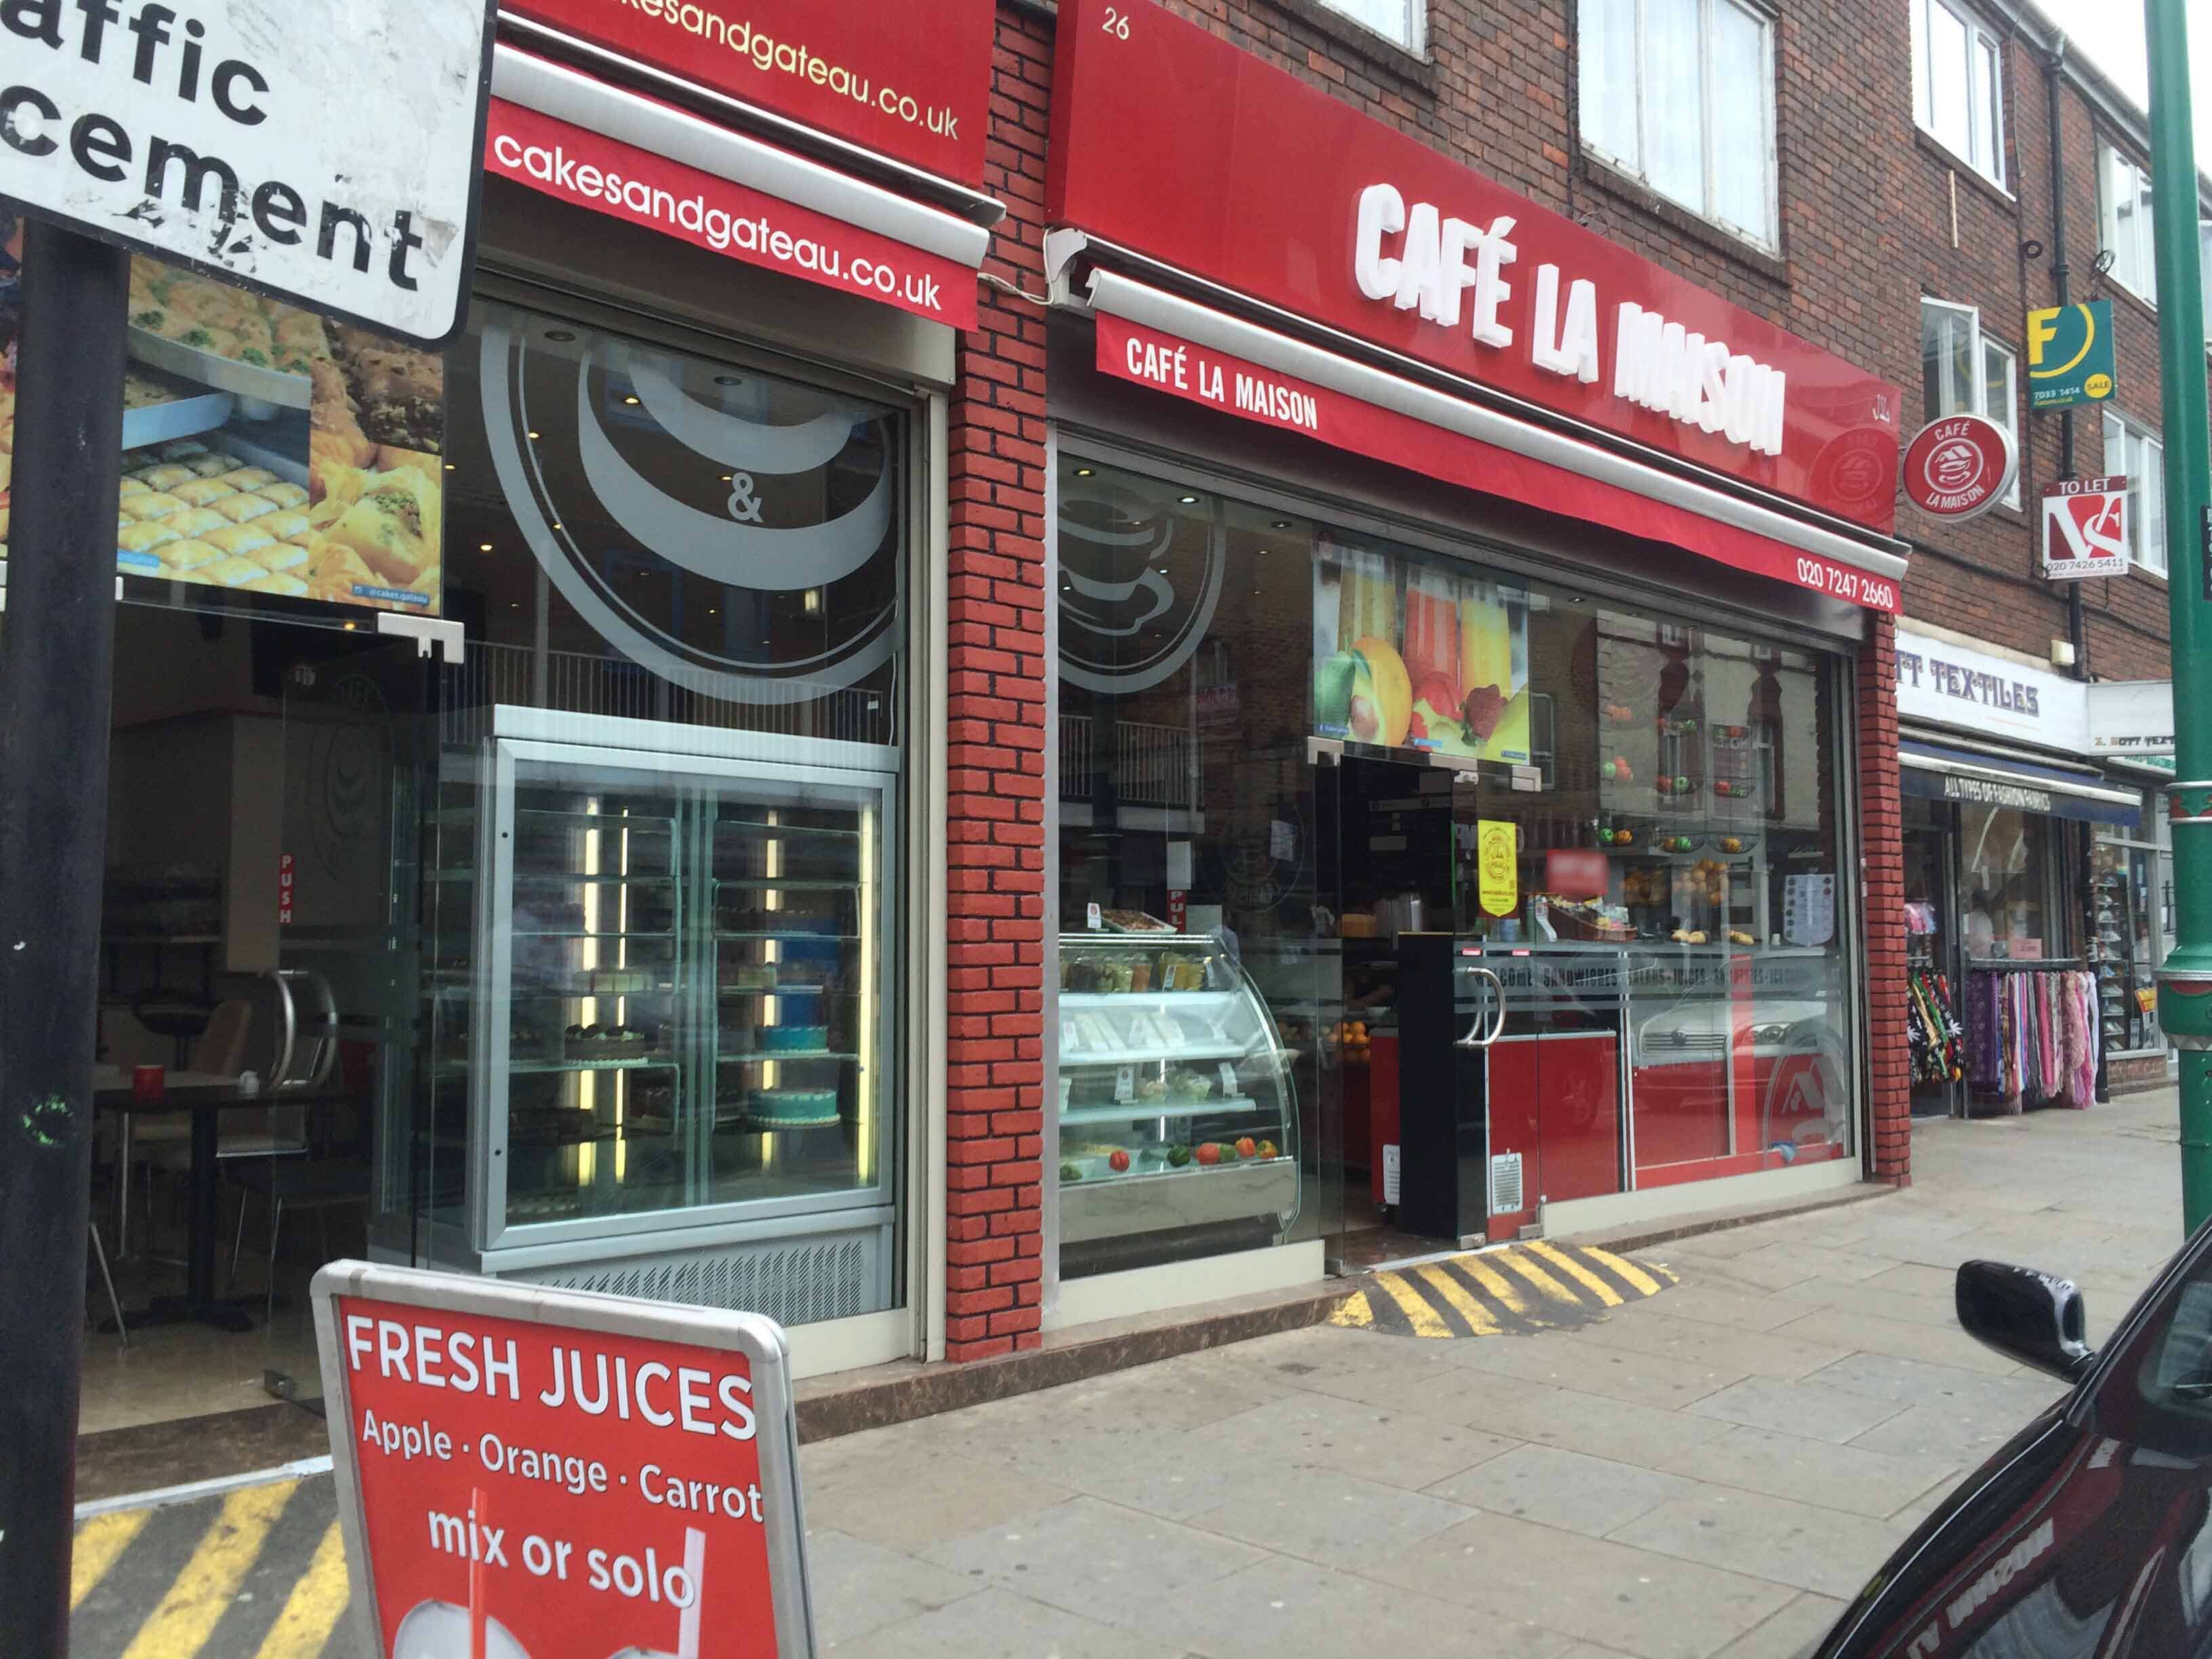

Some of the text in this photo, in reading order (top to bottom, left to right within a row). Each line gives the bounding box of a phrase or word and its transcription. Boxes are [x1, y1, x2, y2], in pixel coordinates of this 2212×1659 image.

[1102, 7, 1130, 41] 26
[0, 85, 424, 291] cement
[494, 134, 942, 311] cakesandgateau.co.uk
[1354, 182, 1786, 456] CAFÉ LA MAISON
[1126, 337, 1318, 430] CAFÉ LA MAISON
[2034, 390, 2056, 400] 7033
[2087, 380, 2110, 391] SALE
[1933, 421, 1969, 441] CAFÉ
[726, 472, 764, 523] &
[1925, 485, 1984, 509] LA MAISON
[2059, 478, 2110, 495] TO LET
[1797, 558, 1893, 608] 020 7247 2660
[2070, 560, 2095, 570] 7426
[2097, 558, 2124, 567] 5411
[1929, 658, 2040, 718] TEXTILES
[281, 855, 293, 924] PUSH
[345, 1313, 758, 1441] FRESH JUICES
[362, 1408, 764, 1523] Apple Orange Carrot
[428, 1509, 697, 1609] mix or solo
